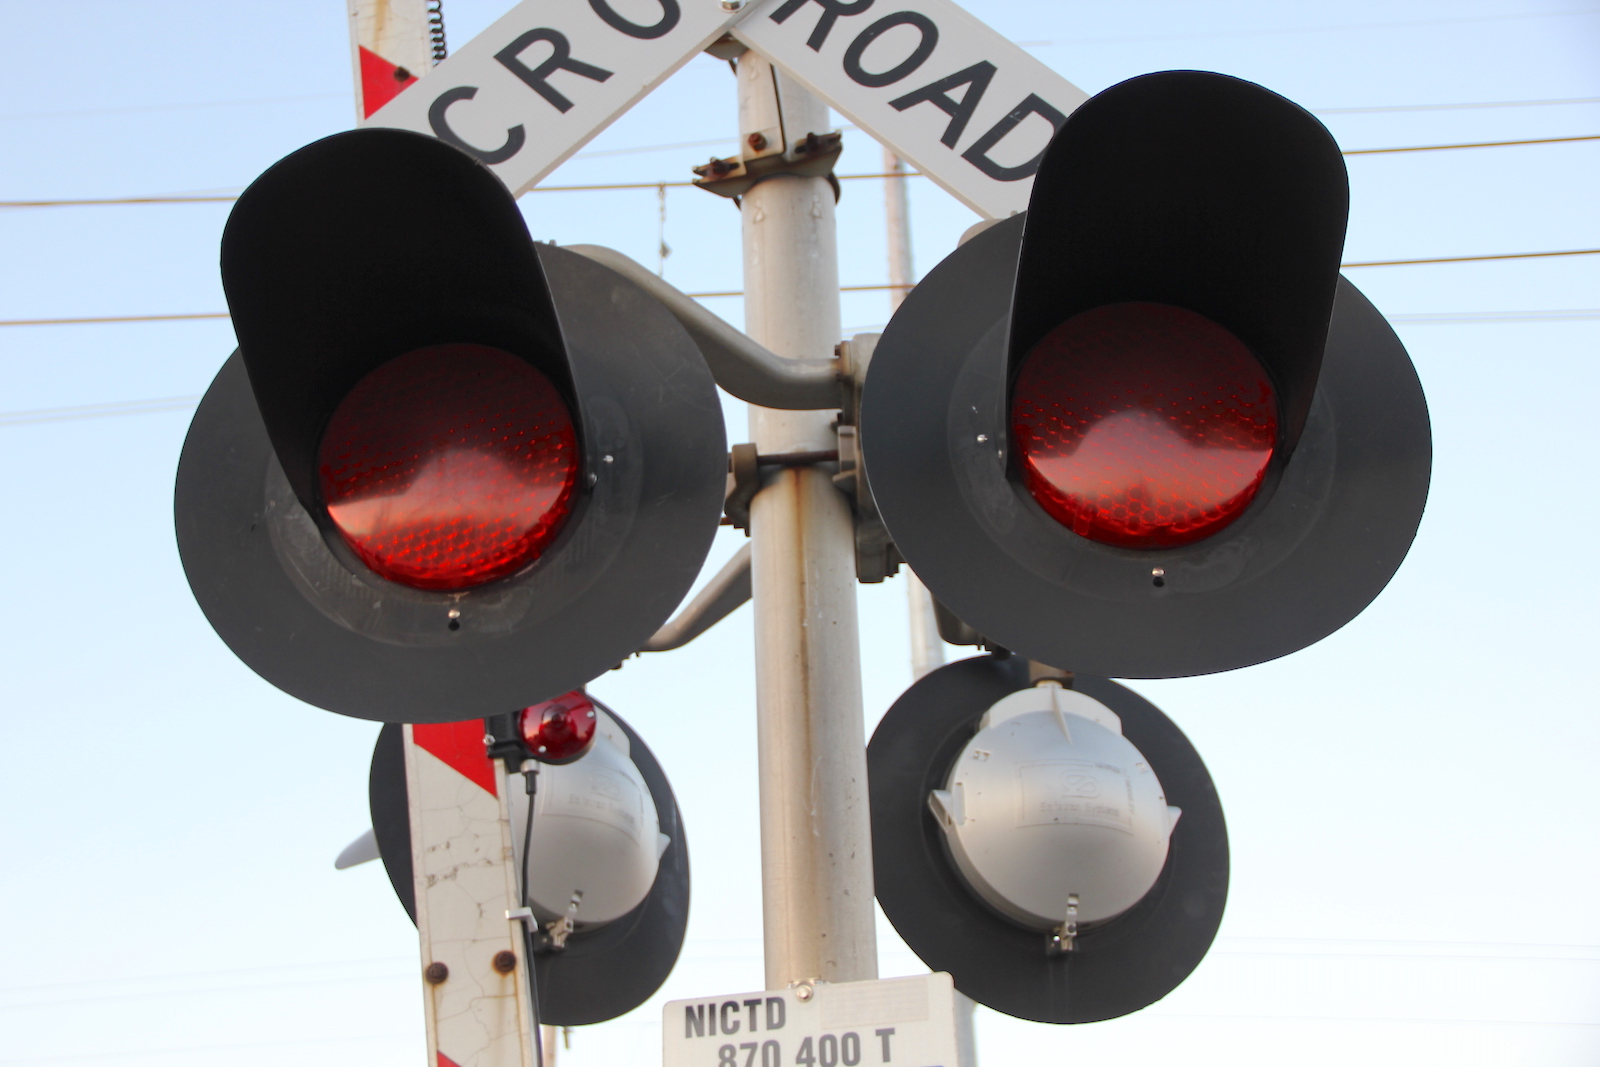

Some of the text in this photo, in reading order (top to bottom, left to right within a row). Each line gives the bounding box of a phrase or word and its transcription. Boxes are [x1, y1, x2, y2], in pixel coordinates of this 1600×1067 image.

[769, 0, 1068, 182] ROAD
[685, 996, 786, 1038] NICTD
[718, 1027, 896, 1067] 870 400 T
